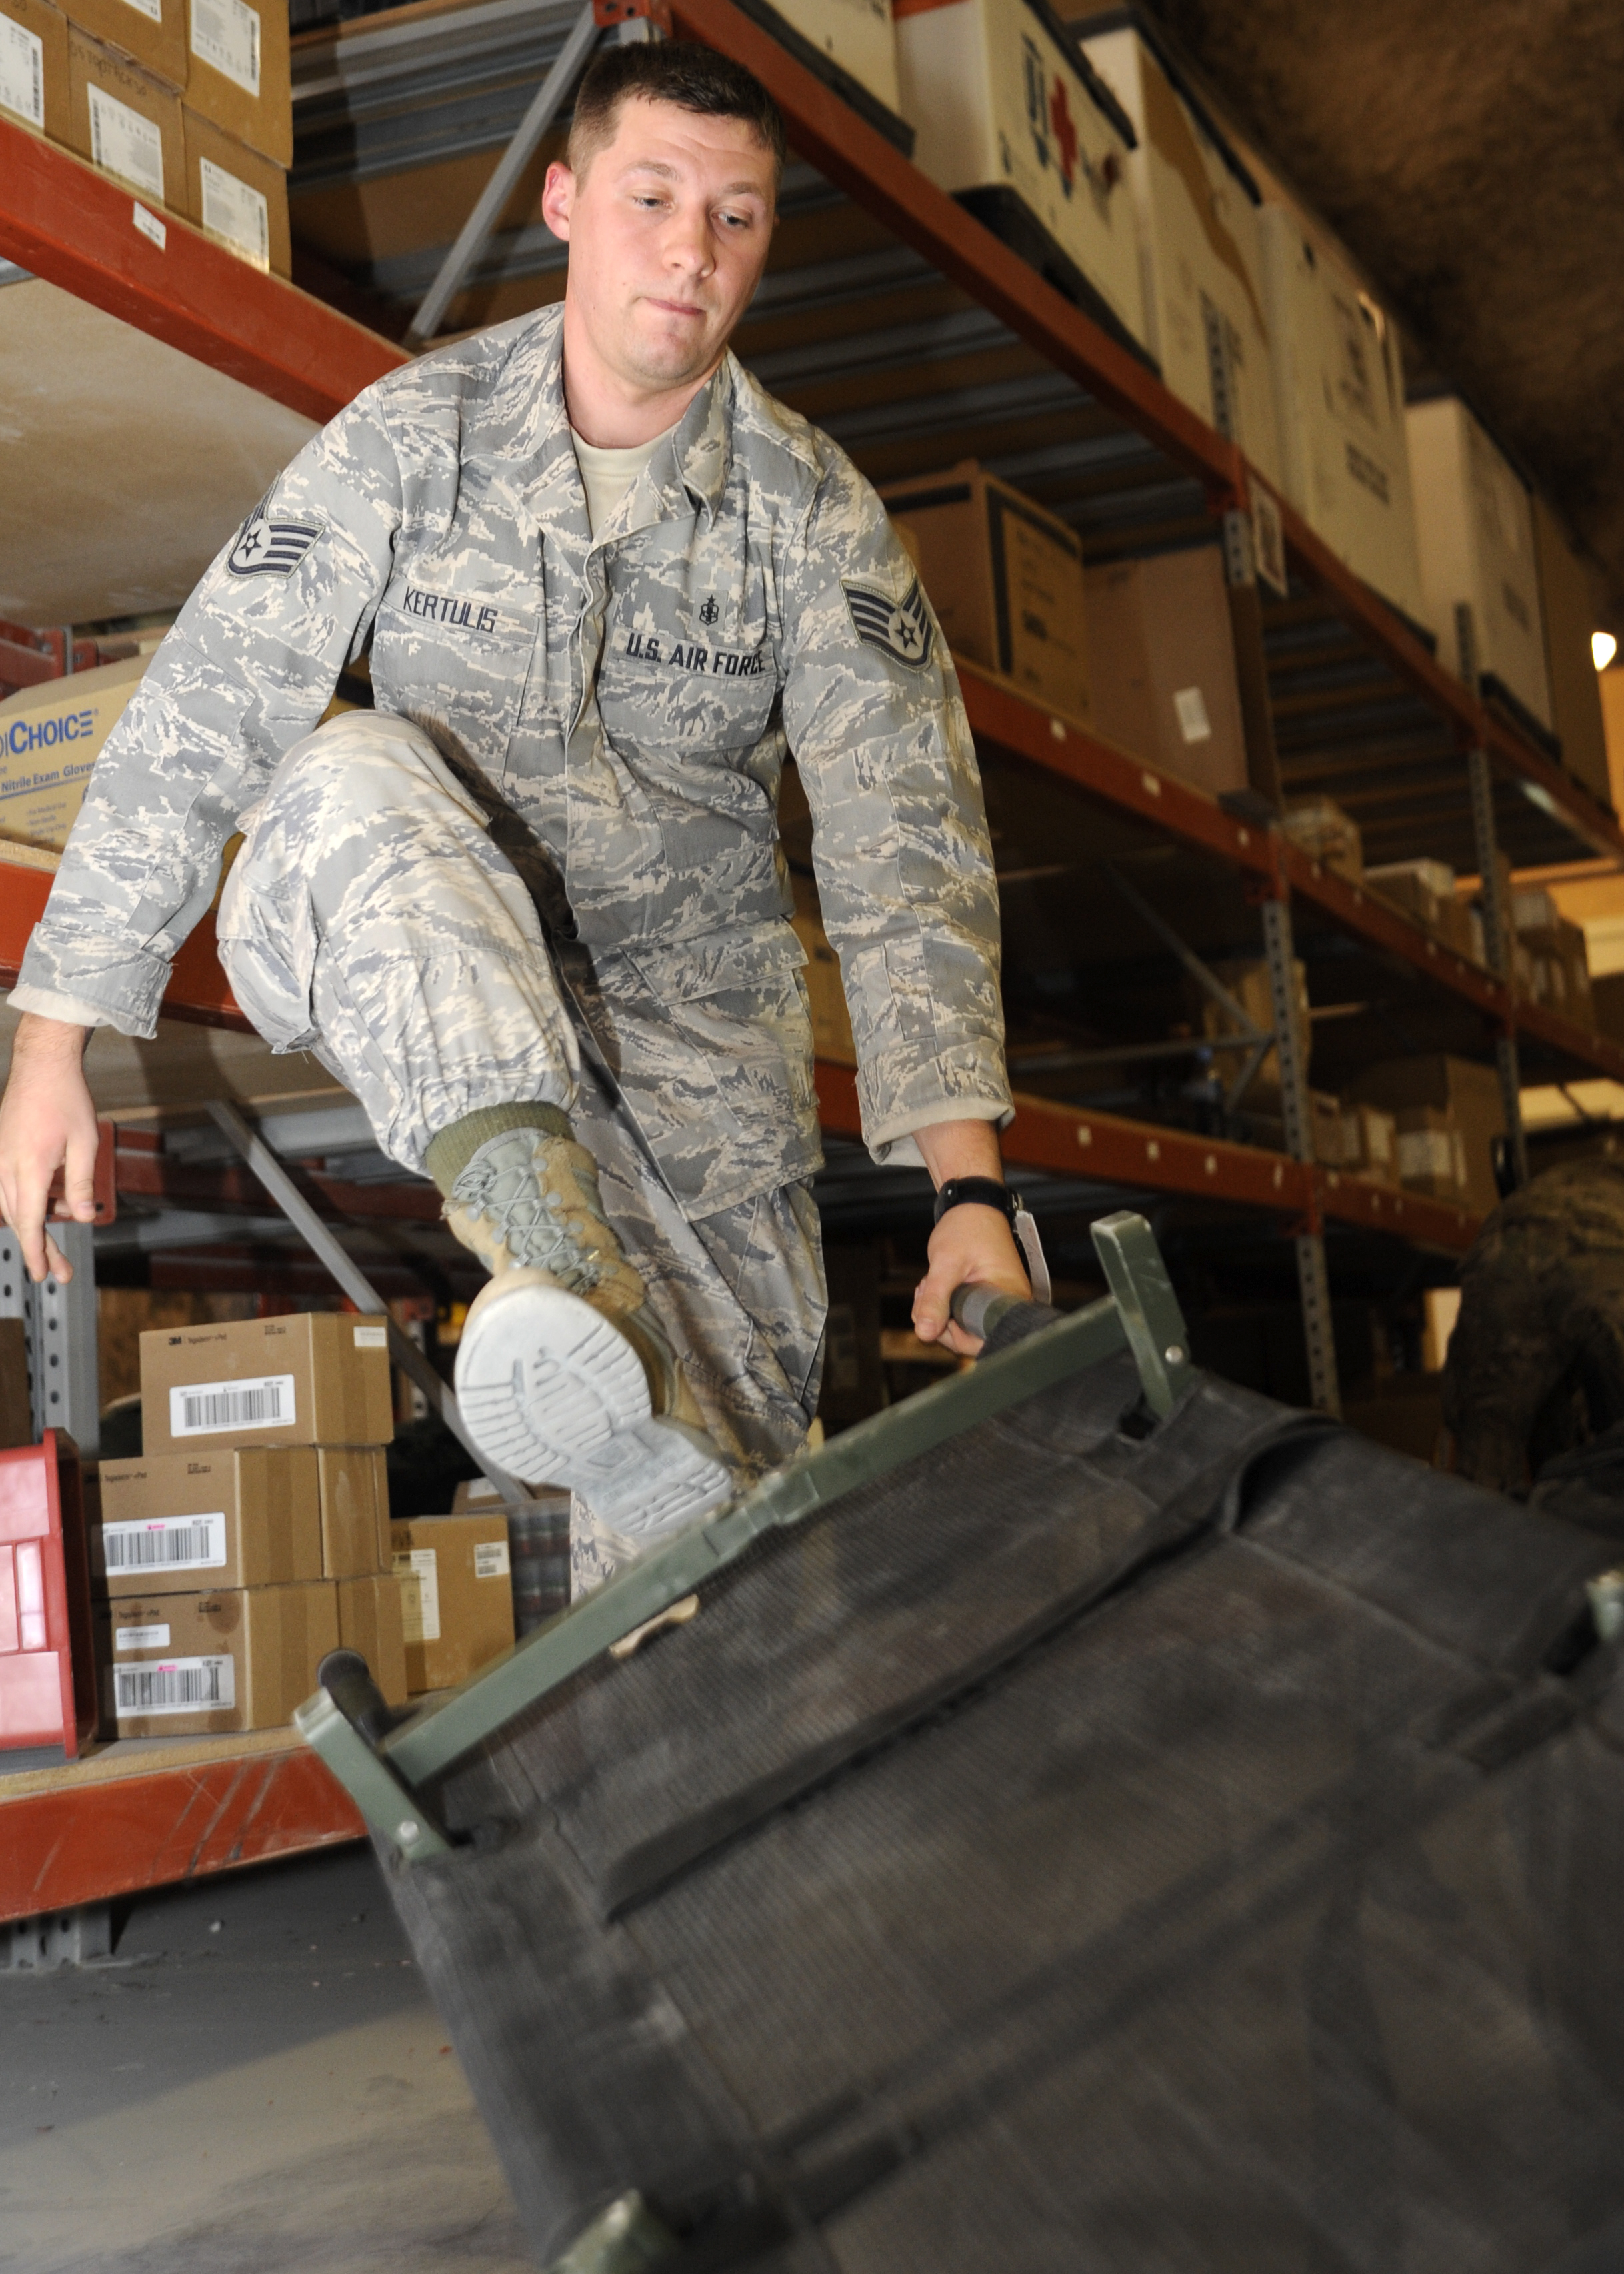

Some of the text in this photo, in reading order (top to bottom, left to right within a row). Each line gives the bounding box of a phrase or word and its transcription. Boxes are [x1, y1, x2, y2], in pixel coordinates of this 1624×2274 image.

[402, 586, 498, 633] KERTULIS
[625, 632, 766, 677] U.S. AIR FORCE
[2, 776, 31, 792] Nitrile
[33, 770, 60, 785] Exam
